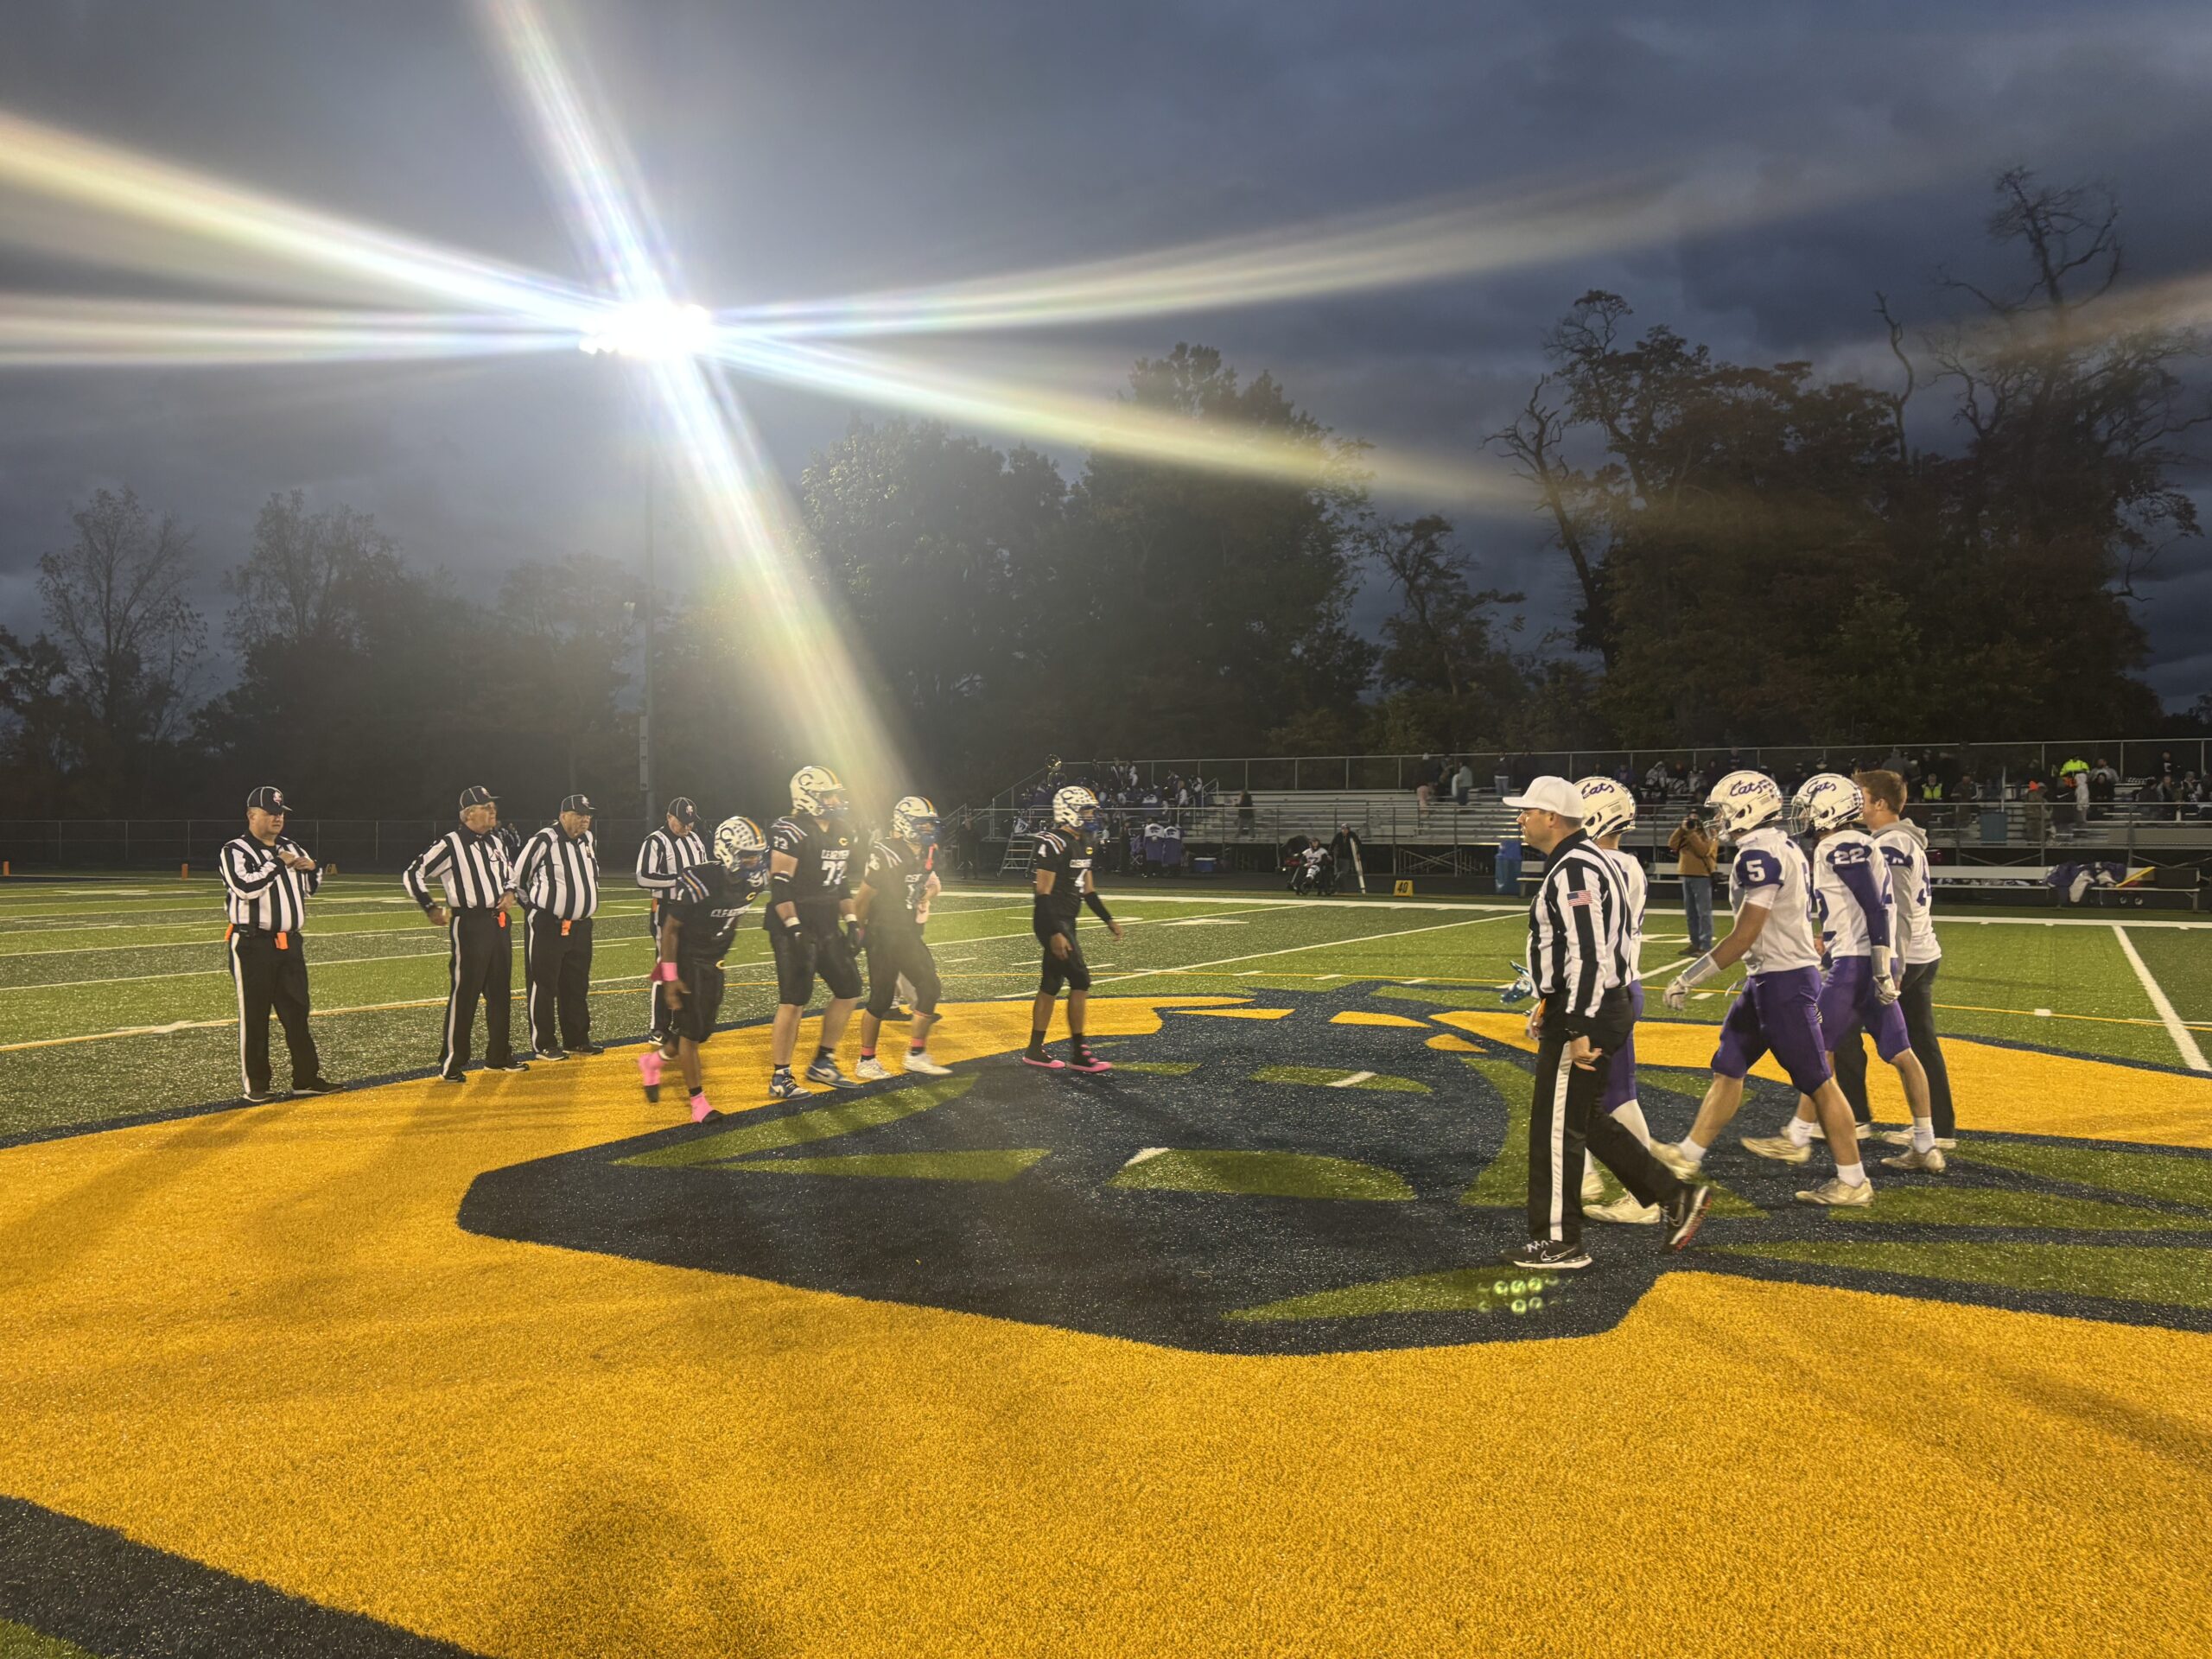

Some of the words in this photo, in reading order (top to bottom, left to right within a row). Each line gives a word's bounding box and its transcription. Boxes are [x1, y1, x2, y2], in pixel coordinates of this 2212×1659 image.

[1730, 779, 1763, 797] Cats
[1807, 779, 1837, 796] Cats
[1833, 848, 1866, 865] 22
[1745, 859, 1766, 882] 5
[1397, 881, 1409, 893] 40
